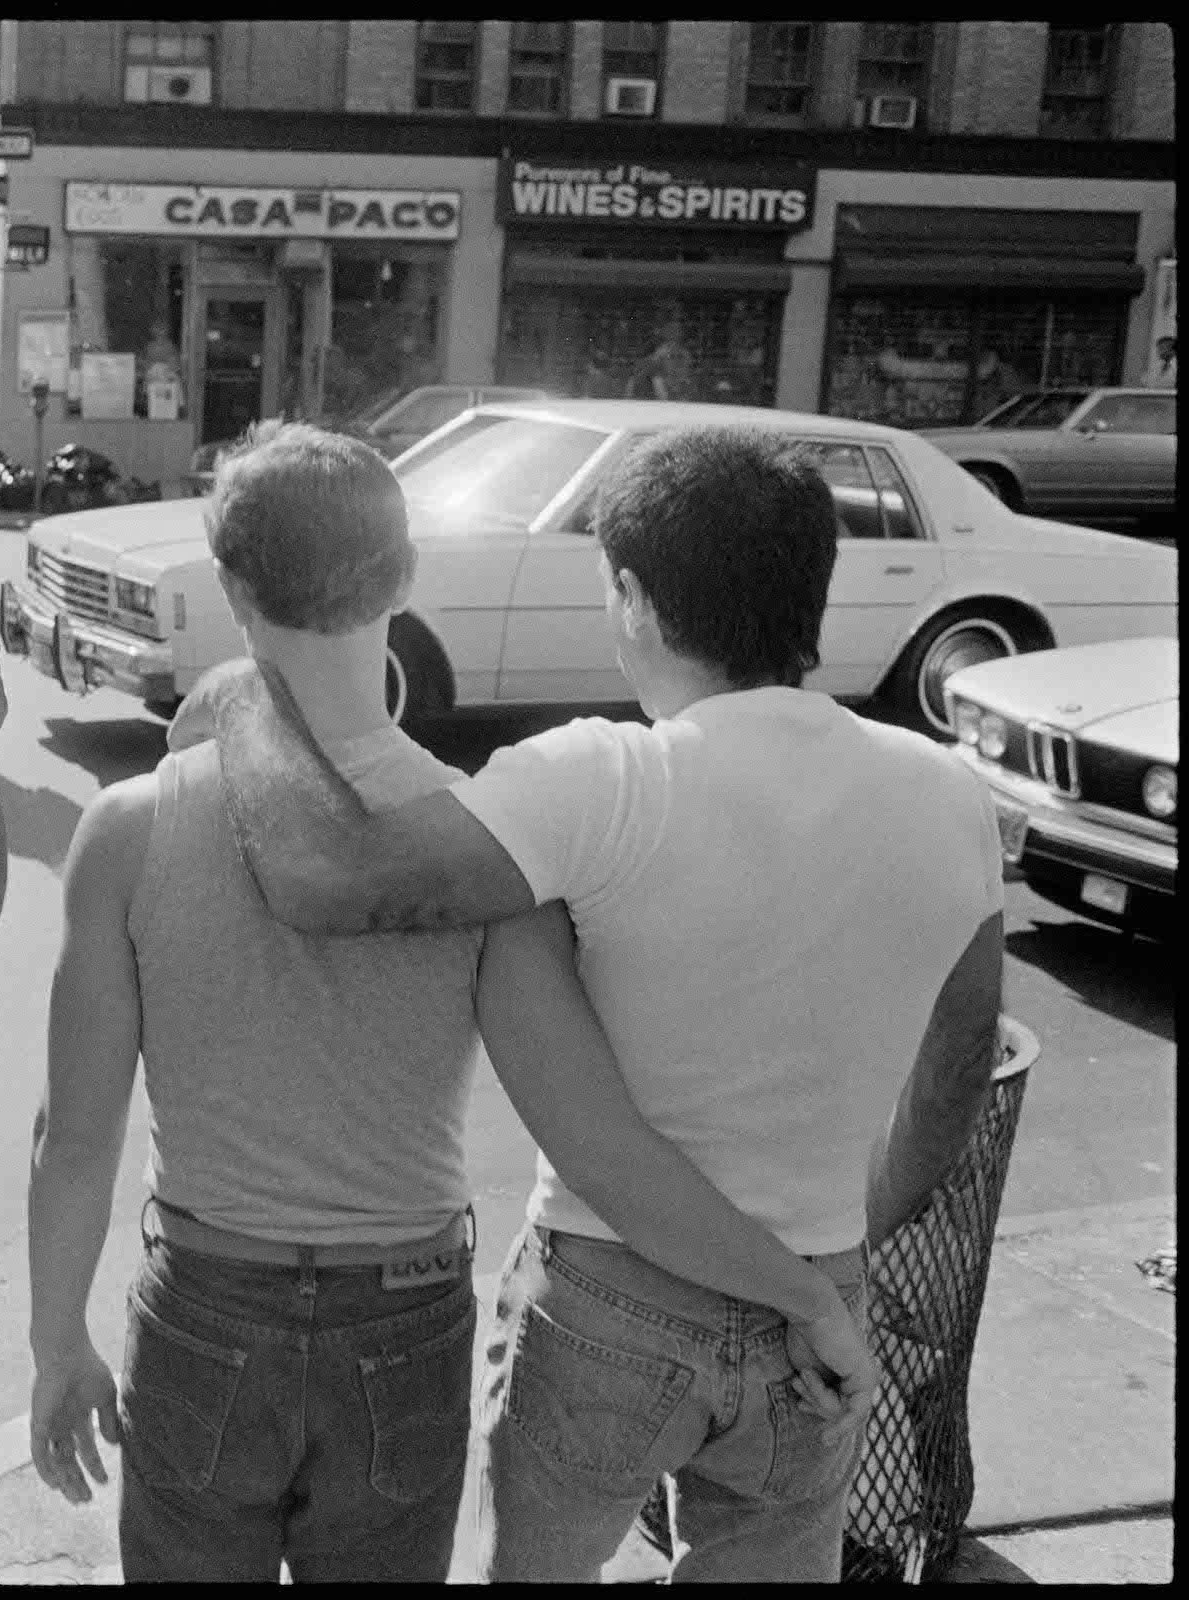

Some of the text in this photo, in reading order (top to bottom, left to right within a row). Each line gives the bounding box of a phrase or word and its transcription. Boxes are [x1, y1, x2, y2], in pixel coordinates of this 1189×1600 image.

[165, 196, 293, 228] CASA
[327, 199, 457, 229] PACO
[513, 181, 638, 217] WINES
[658, 185, 807, 222] SPIRITS
